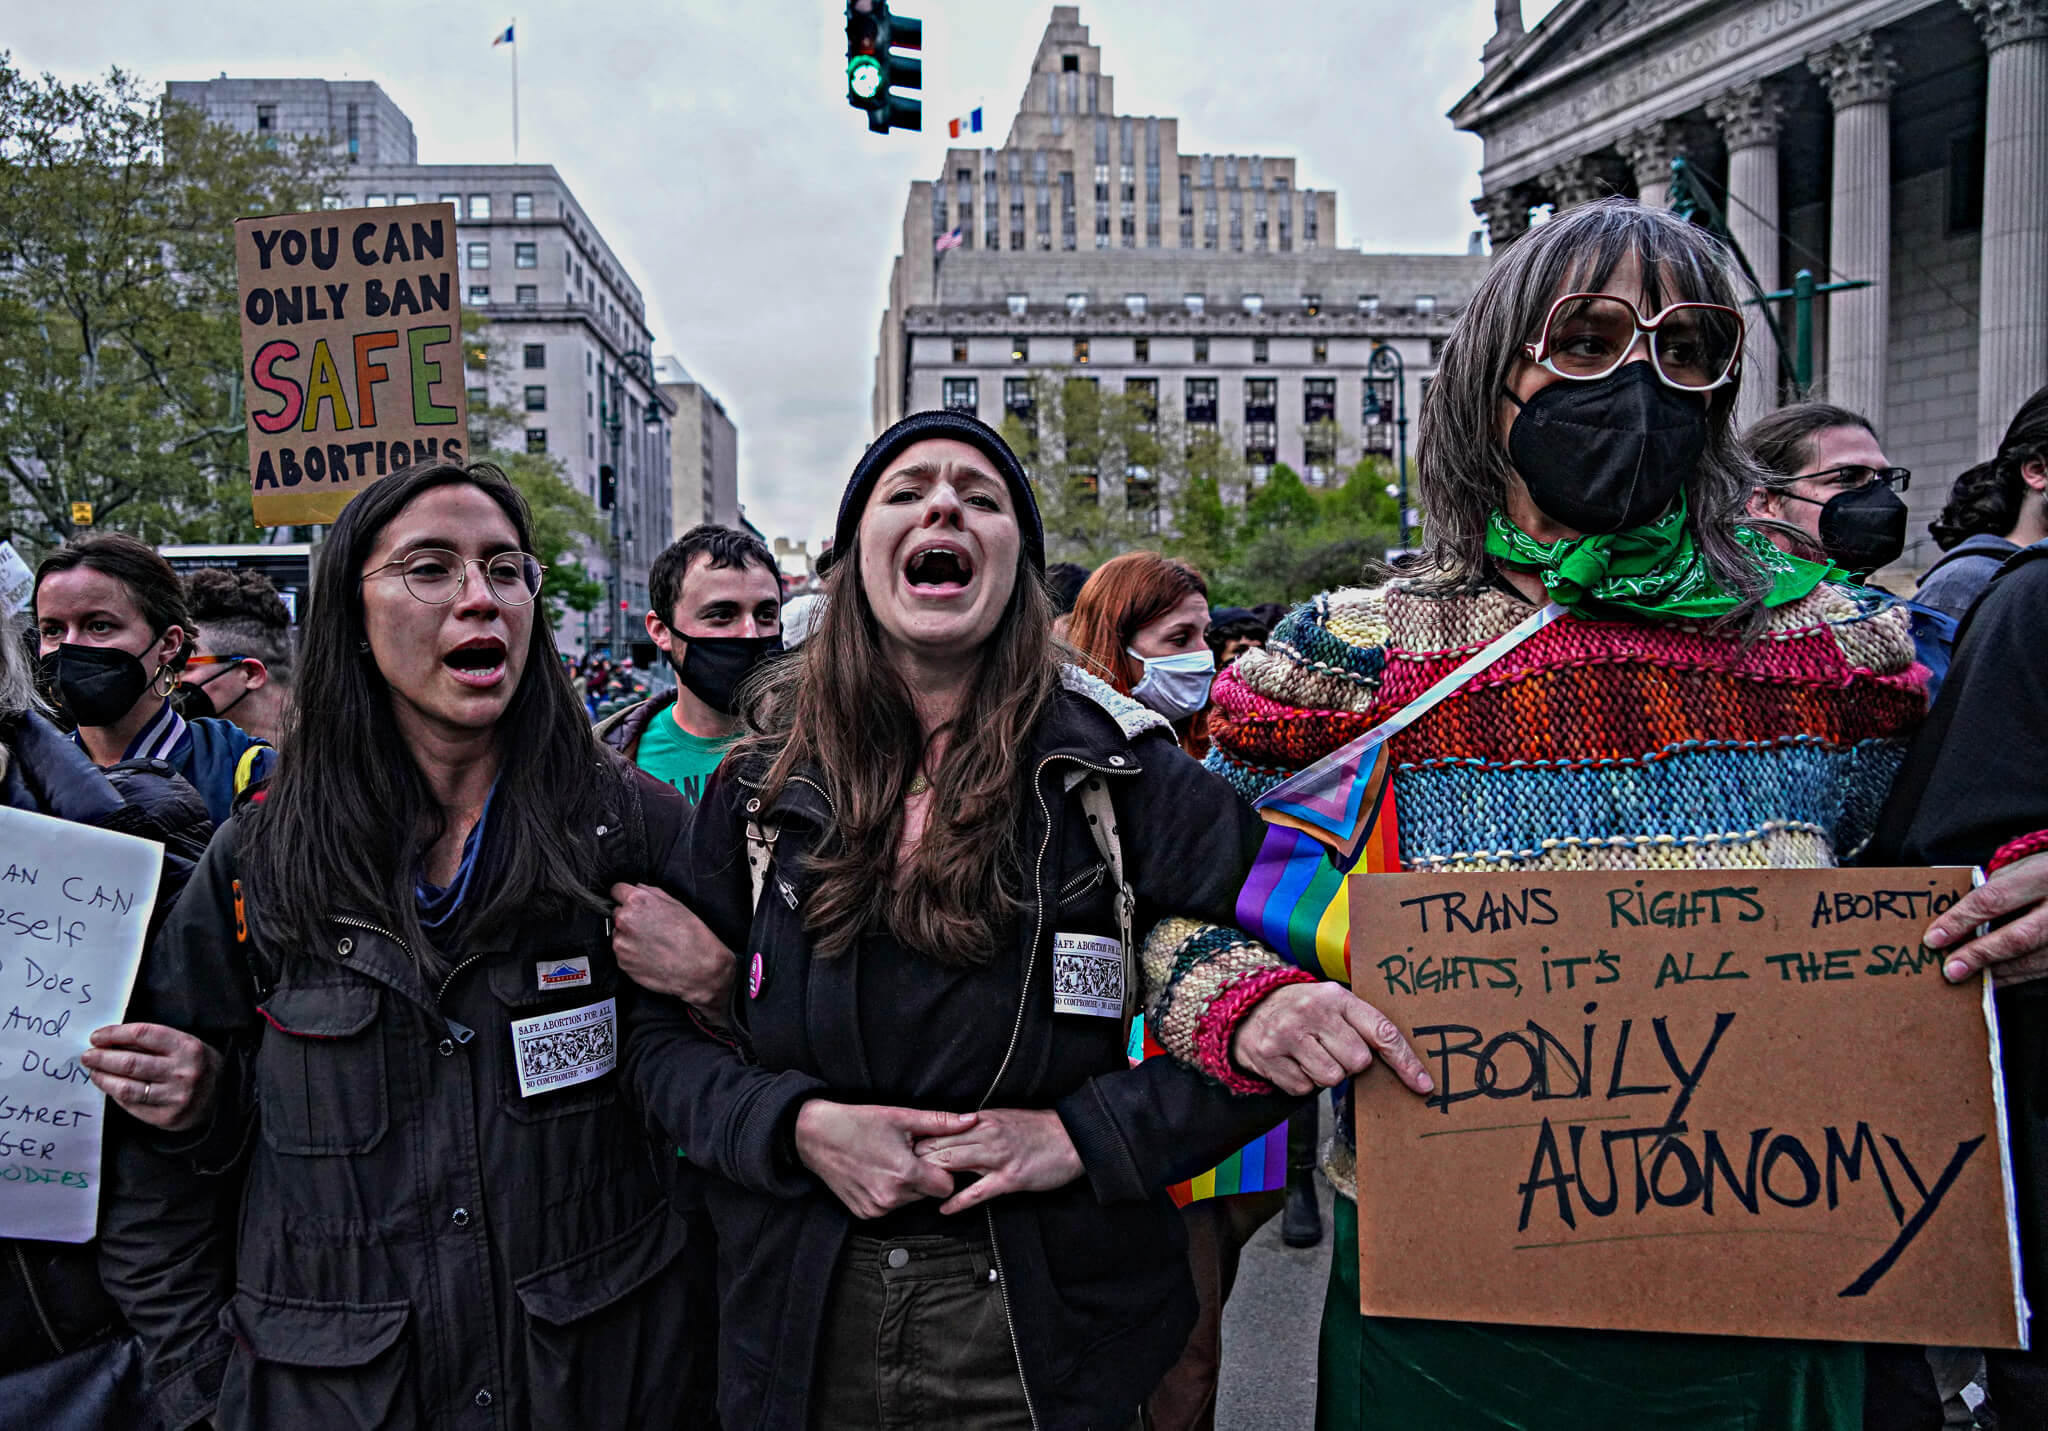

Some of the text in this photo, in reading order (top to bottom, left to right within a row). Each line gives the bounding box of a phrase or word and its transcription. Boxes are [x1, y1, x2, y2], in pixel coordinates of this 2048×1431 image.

[1726, 17, 1755, 48] OF
[251, 219, 444, 270] YOU CAN
[246, 273, 450, 326] ONLY BAN
[251, 324, 458, 434] SAFE
[254, 437, 463, 490] ABORTIONS
[62, 876, 134, 915] CAN
[1400, 888, 1559, 934] TRANS
[25, 956, 92, 1004] Does
[1654, 951, 1750, 990] ALL
[1765, 949, 1861, 984] THE
[1865, 943, 1946, 976] SAM
[2, 1005, 71, 1038] And
[518, 1005, 612, 1036] SAFE ABORTION FOR ALL
[525, 1080, 536, 1089] NO
[0, 1165, 89, 1188] ODIES
[1517, 1117, 1987, 1298] AUTONOMY
